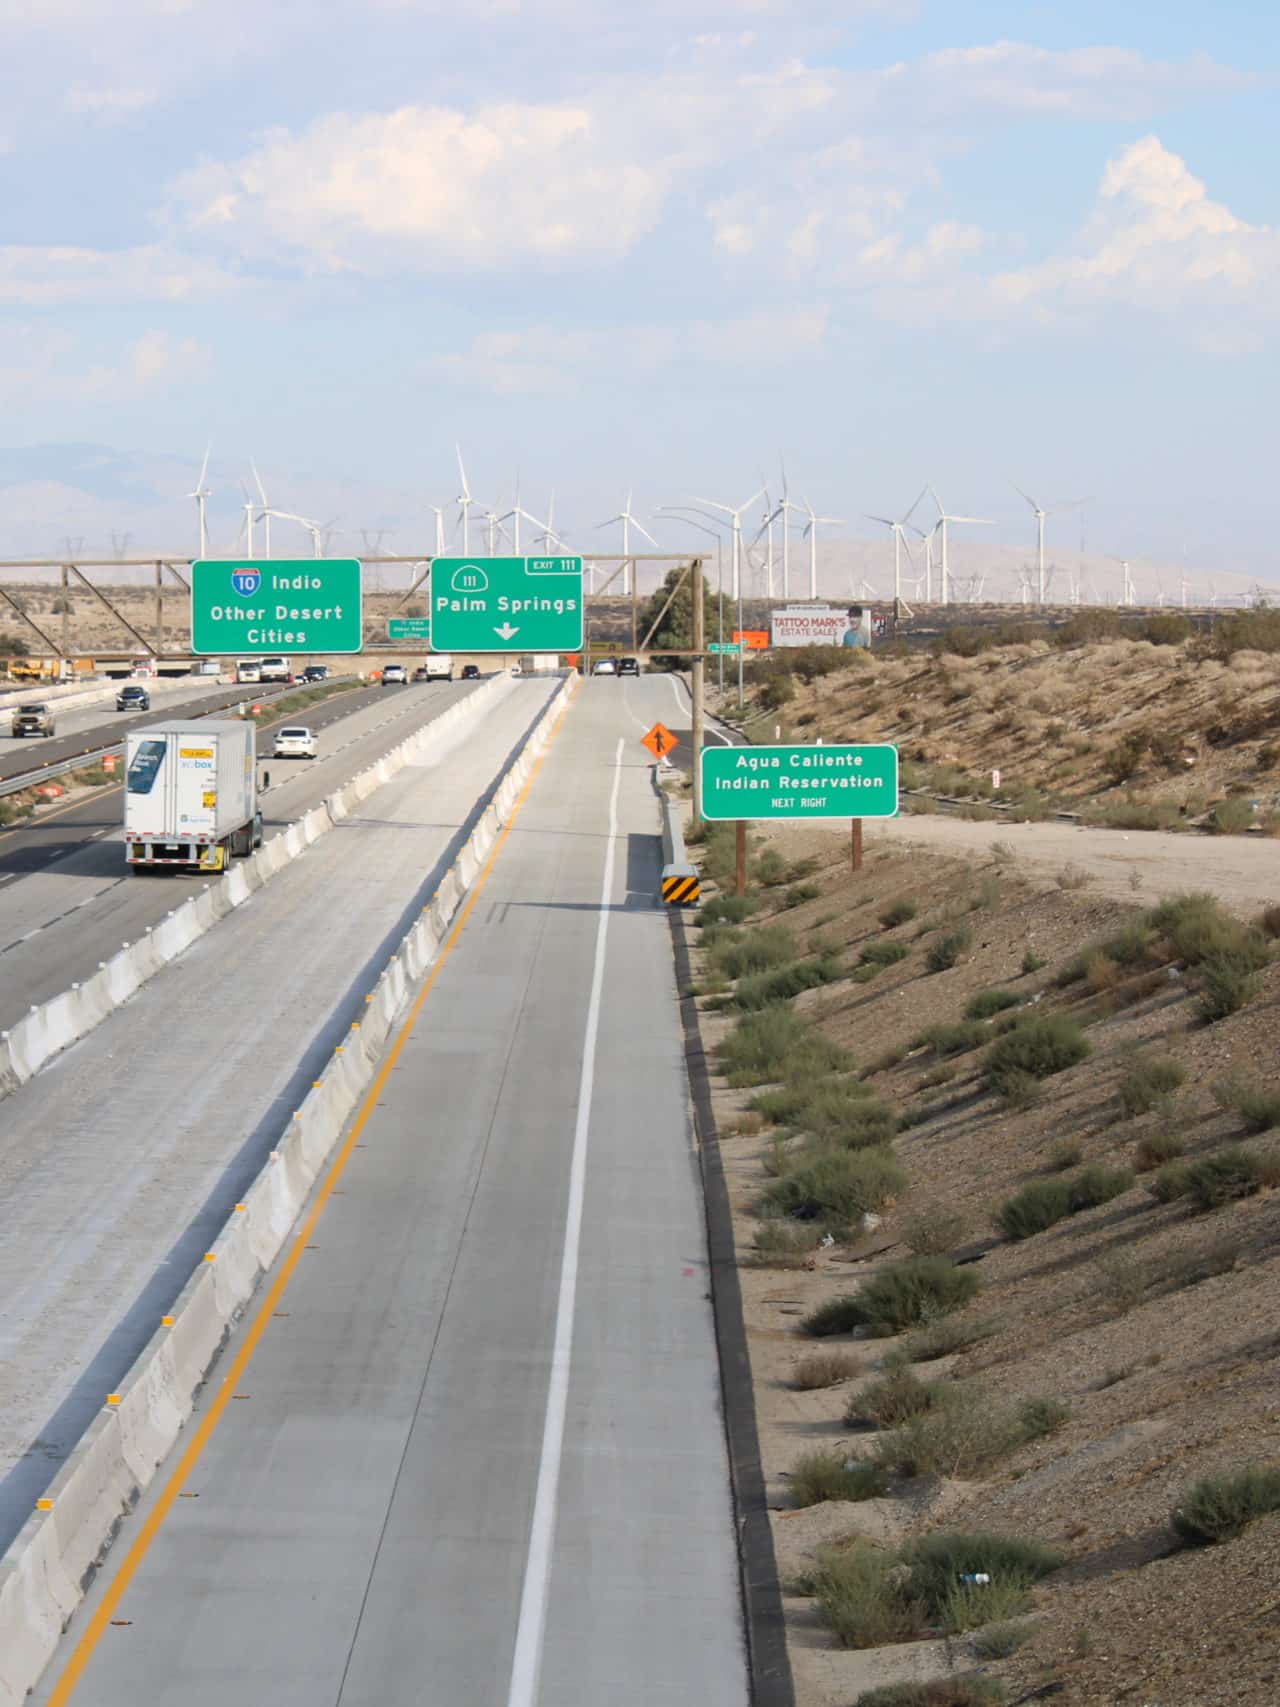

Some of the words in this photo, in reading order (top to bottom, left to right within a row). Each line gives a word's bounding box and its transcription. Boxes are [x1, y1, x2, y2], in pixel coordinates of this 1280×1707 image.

[533, 561, 554, 569] EXIT
[561, 560, 575, 570] 111
[238, 577, 256, 590] 10
[272, 576, 322, 589] Indio
[463, 576, 476, 586] 111
[436, 597, 486, 611] Palm
[497, 596, 576, 614] Springs
[210, 606, 266, 620] Other
[275, 605, 343, 620] Desert
[774, 618, 809, 627] TATTOO
[811, 618, 846, 627] MARK'S
[247, 629, 306, 643] Cities
[781, 628, 809, 636] ESTATE
[736, 755, 780, 771] Agua
[789, 754, 863, 767] Caliente
[716, 777, 769, 790] Indian
[779, 775, 883, 789] Reservation
[771, 798, 795, 808] NEXT
[801, 797, 827, 808] RIGHT
